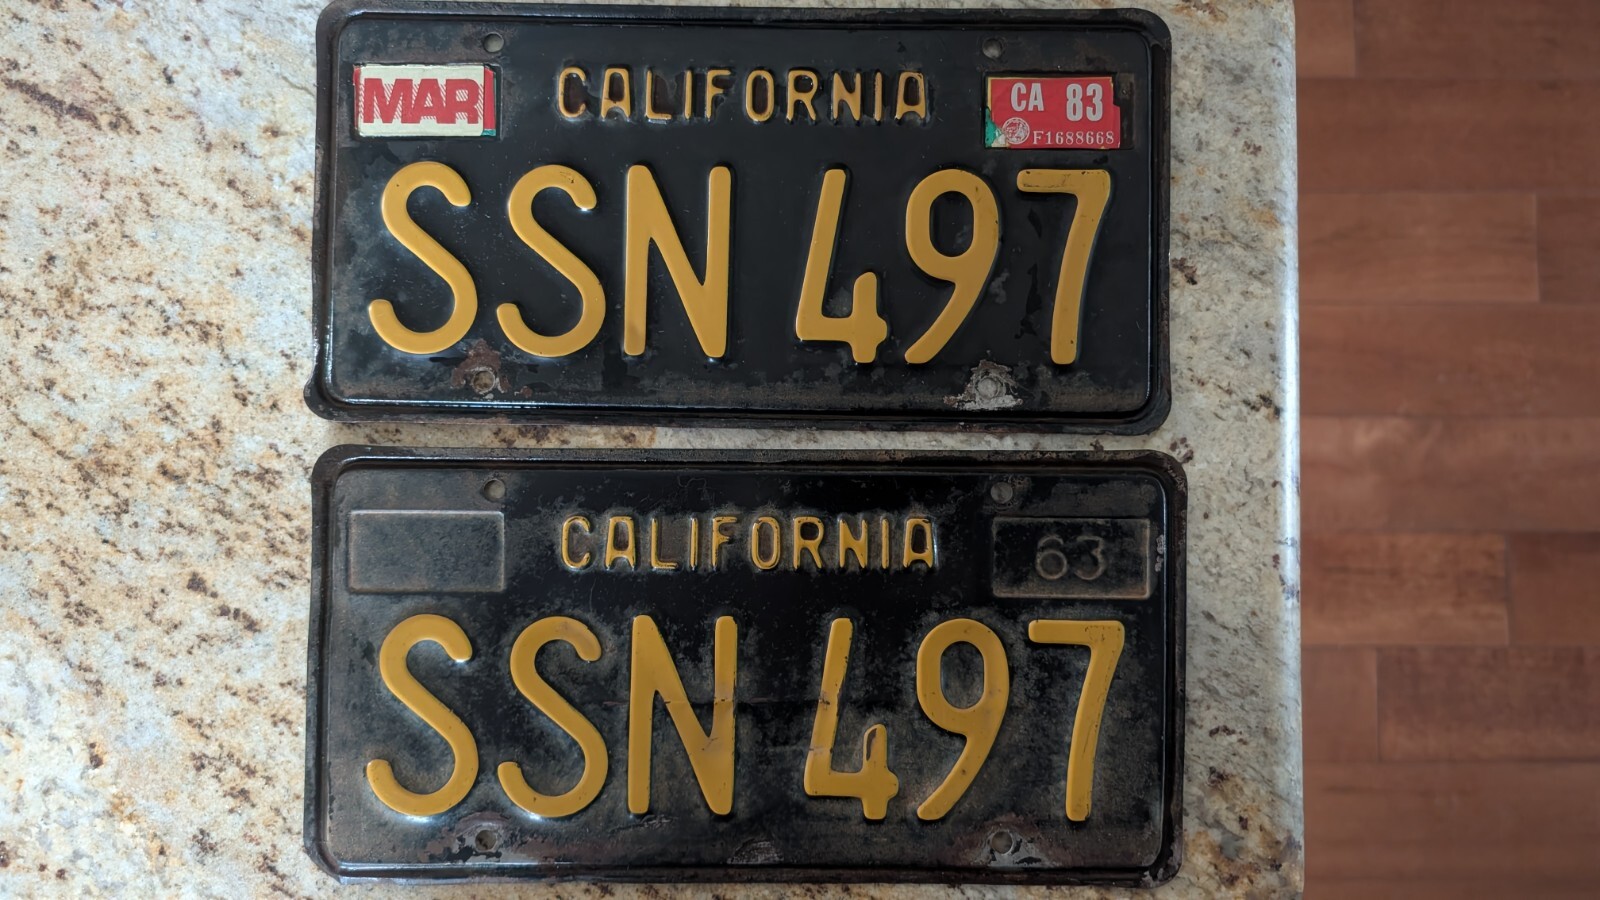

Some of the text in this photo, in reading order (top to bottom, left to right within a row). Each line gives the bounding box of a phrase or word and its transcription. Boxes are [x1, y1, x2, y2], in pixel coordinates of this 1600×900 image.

[362, 78, 481, 124] MAR
[556, 66, 930, 124] CALIFORNIA
[1010, 82, 1103, 122] CA 83
[1032, 130, 1115, 145] F1688668
[368, 160, 1112, 365] SSN 497
[559, 515, 939, 570] CALIFORNIA
[1035, 534, 1105, 581] 63
[366, 613, 1126, 821] SSN 497
